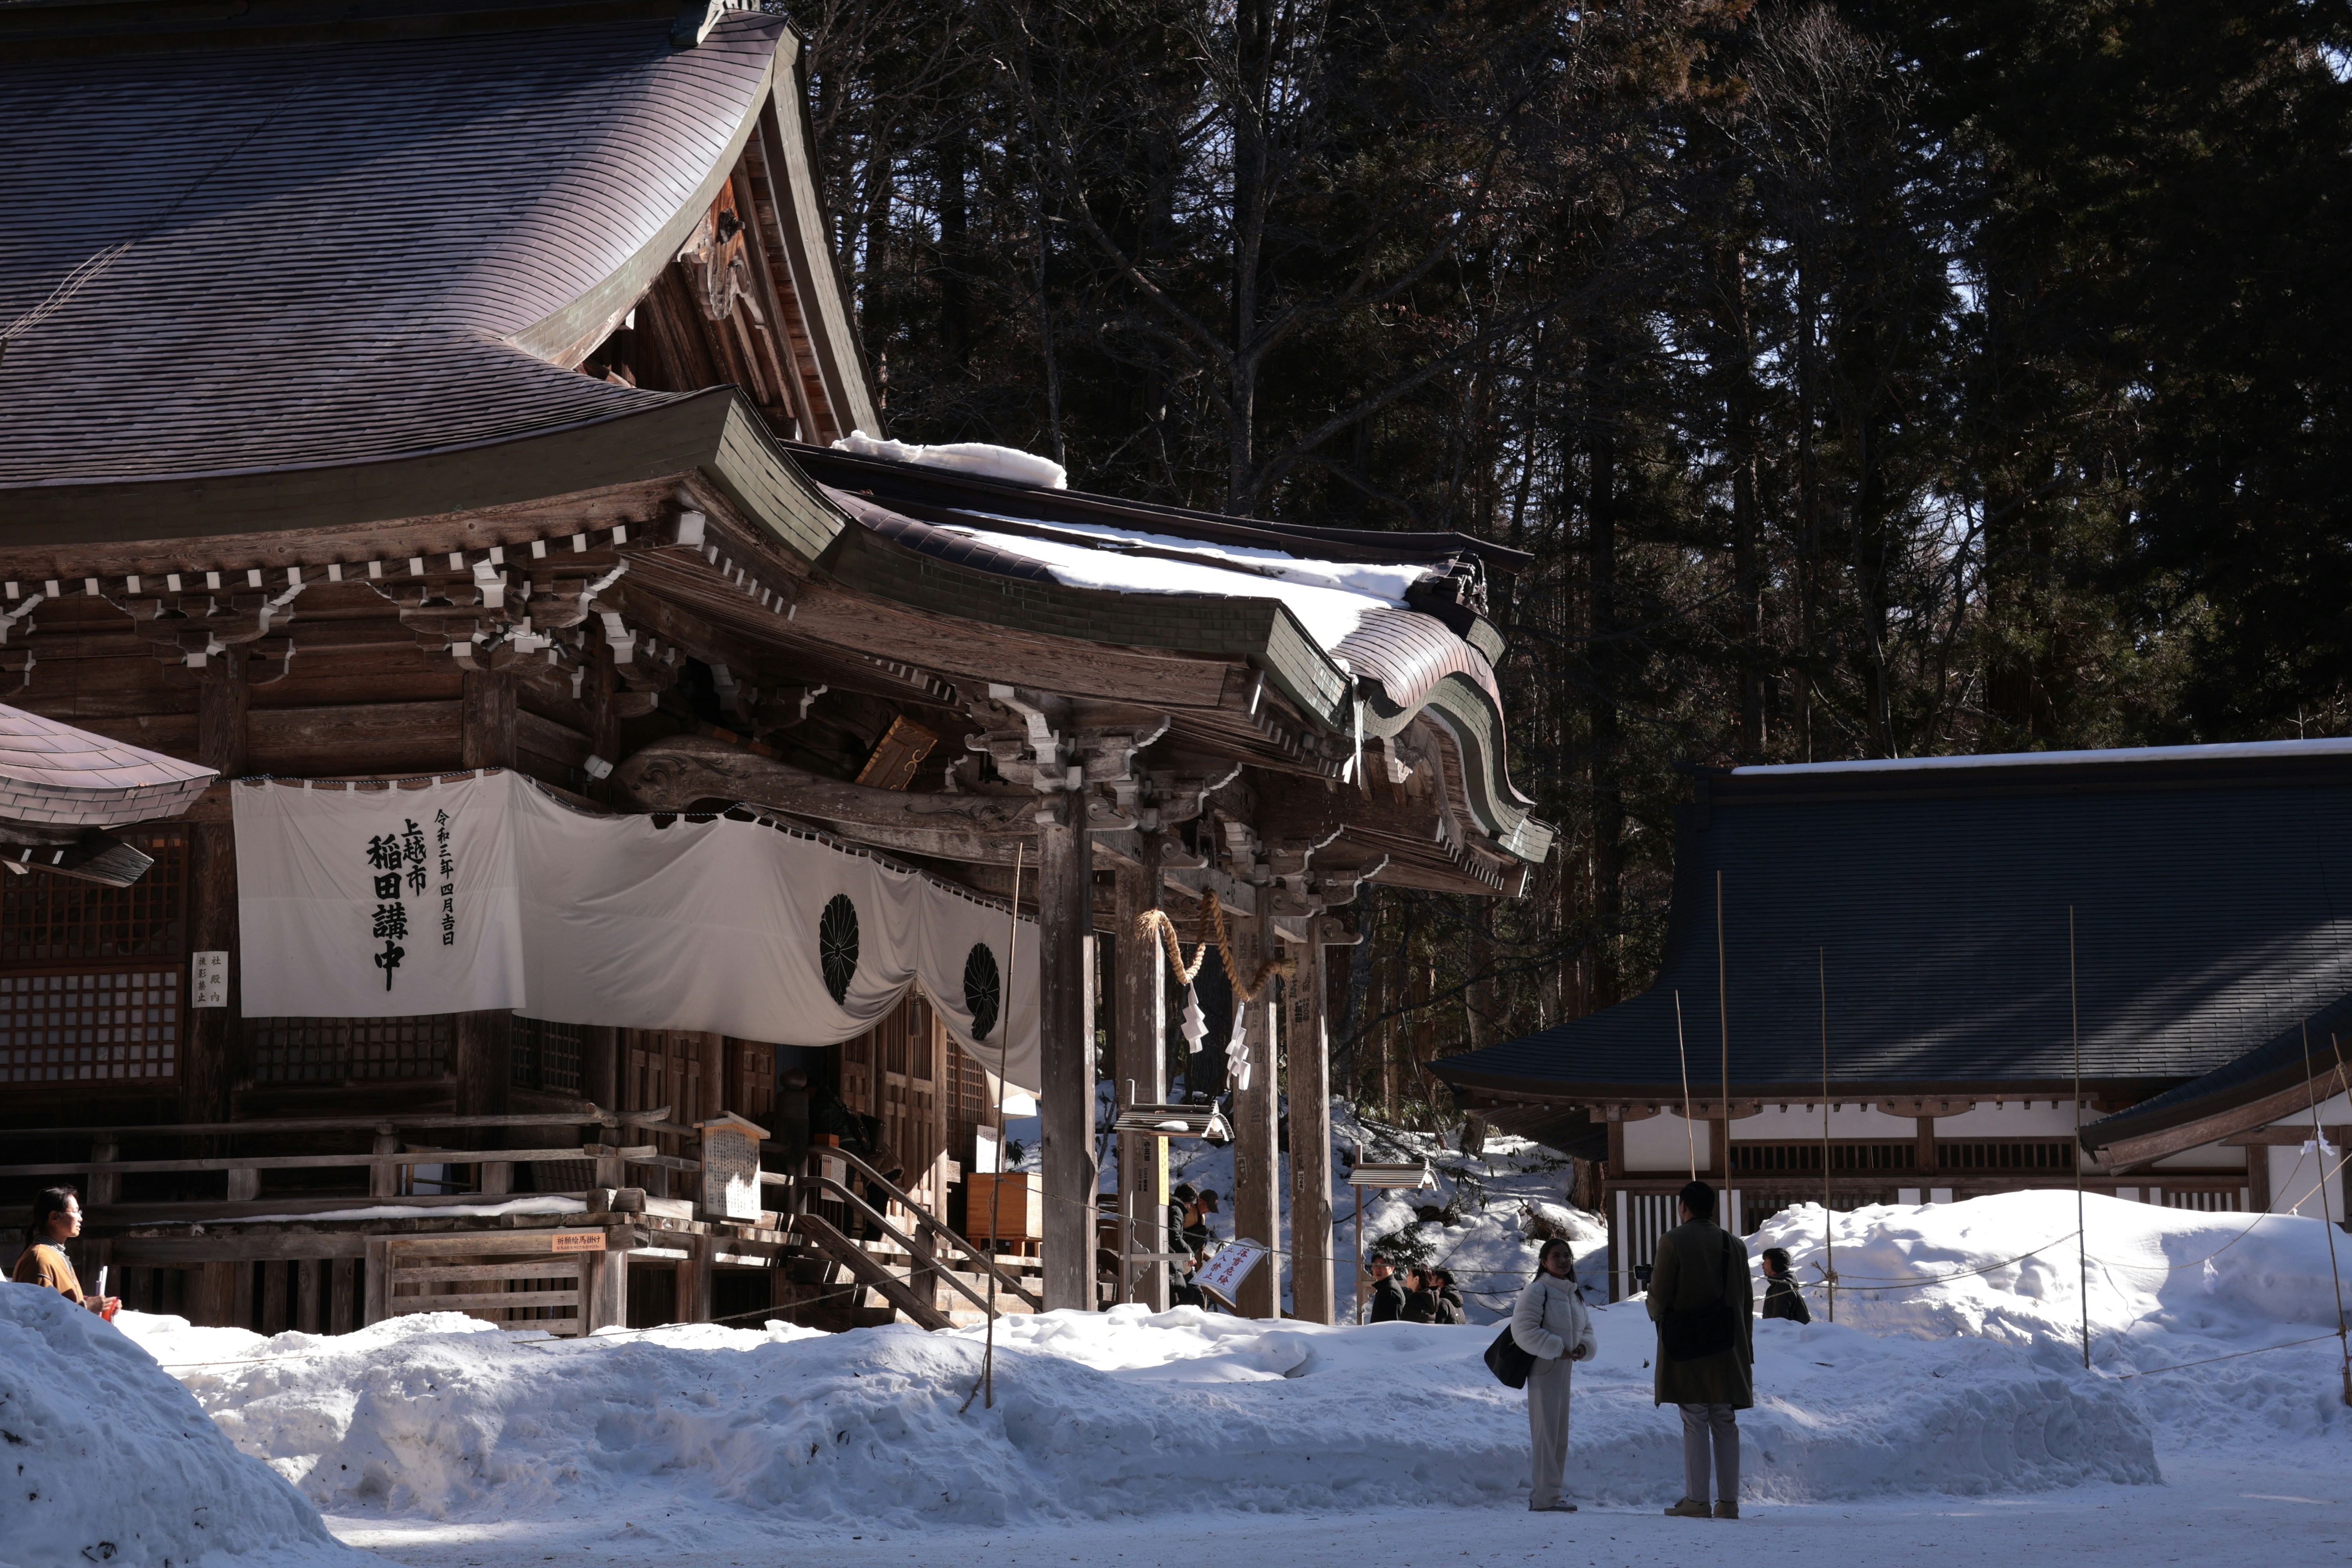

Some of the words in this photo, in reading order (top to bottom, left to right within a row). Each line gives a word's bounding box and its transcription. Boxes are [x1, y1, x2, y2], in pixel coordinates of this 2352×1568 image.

[401, 818, 427, 897] 上越市
[435, 809, 455, 946] 令和三年四月吉日
[366, 833, 408, 992] 稲田講中
[197, 956, 207, 1002] 撮影禁止
[210, 956, 221, 1002] 社殿内
[557, 1236, 601, 1245] 祈願絵馬掛け
[1203, 1248, 1233, 1279] 立入禁止
[1217, 1247, 1250, 1285] 落雪危険
